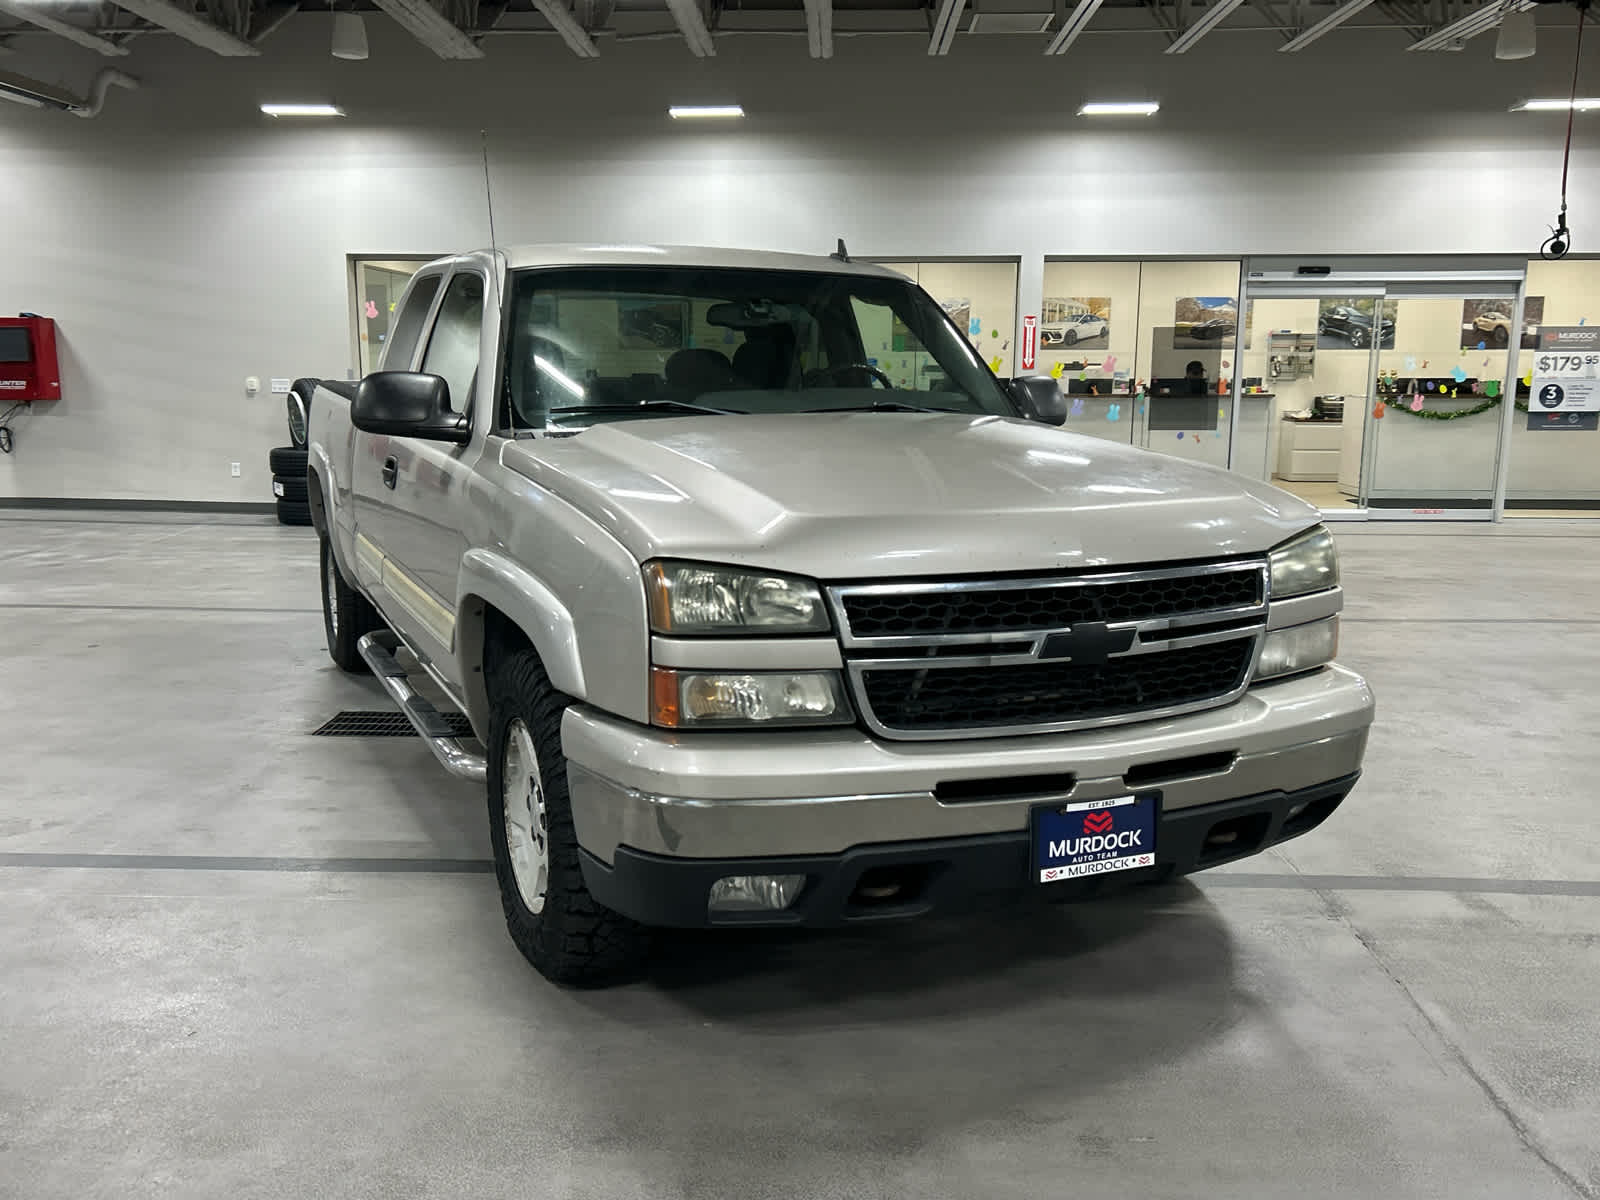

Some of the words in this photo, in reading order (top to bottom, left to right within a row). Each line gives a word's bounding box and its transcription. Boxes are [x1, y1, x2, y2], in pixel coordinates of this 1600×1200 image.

[1546, 386, 1557, 399] 3
[1048, 829, 1142, 858] MURDOCK
[1072, 854, 1094, 863] AUTO
[1096, 850, 1117, 860] TEAM
[1068, 858, 1129, 877] MURDOCK
